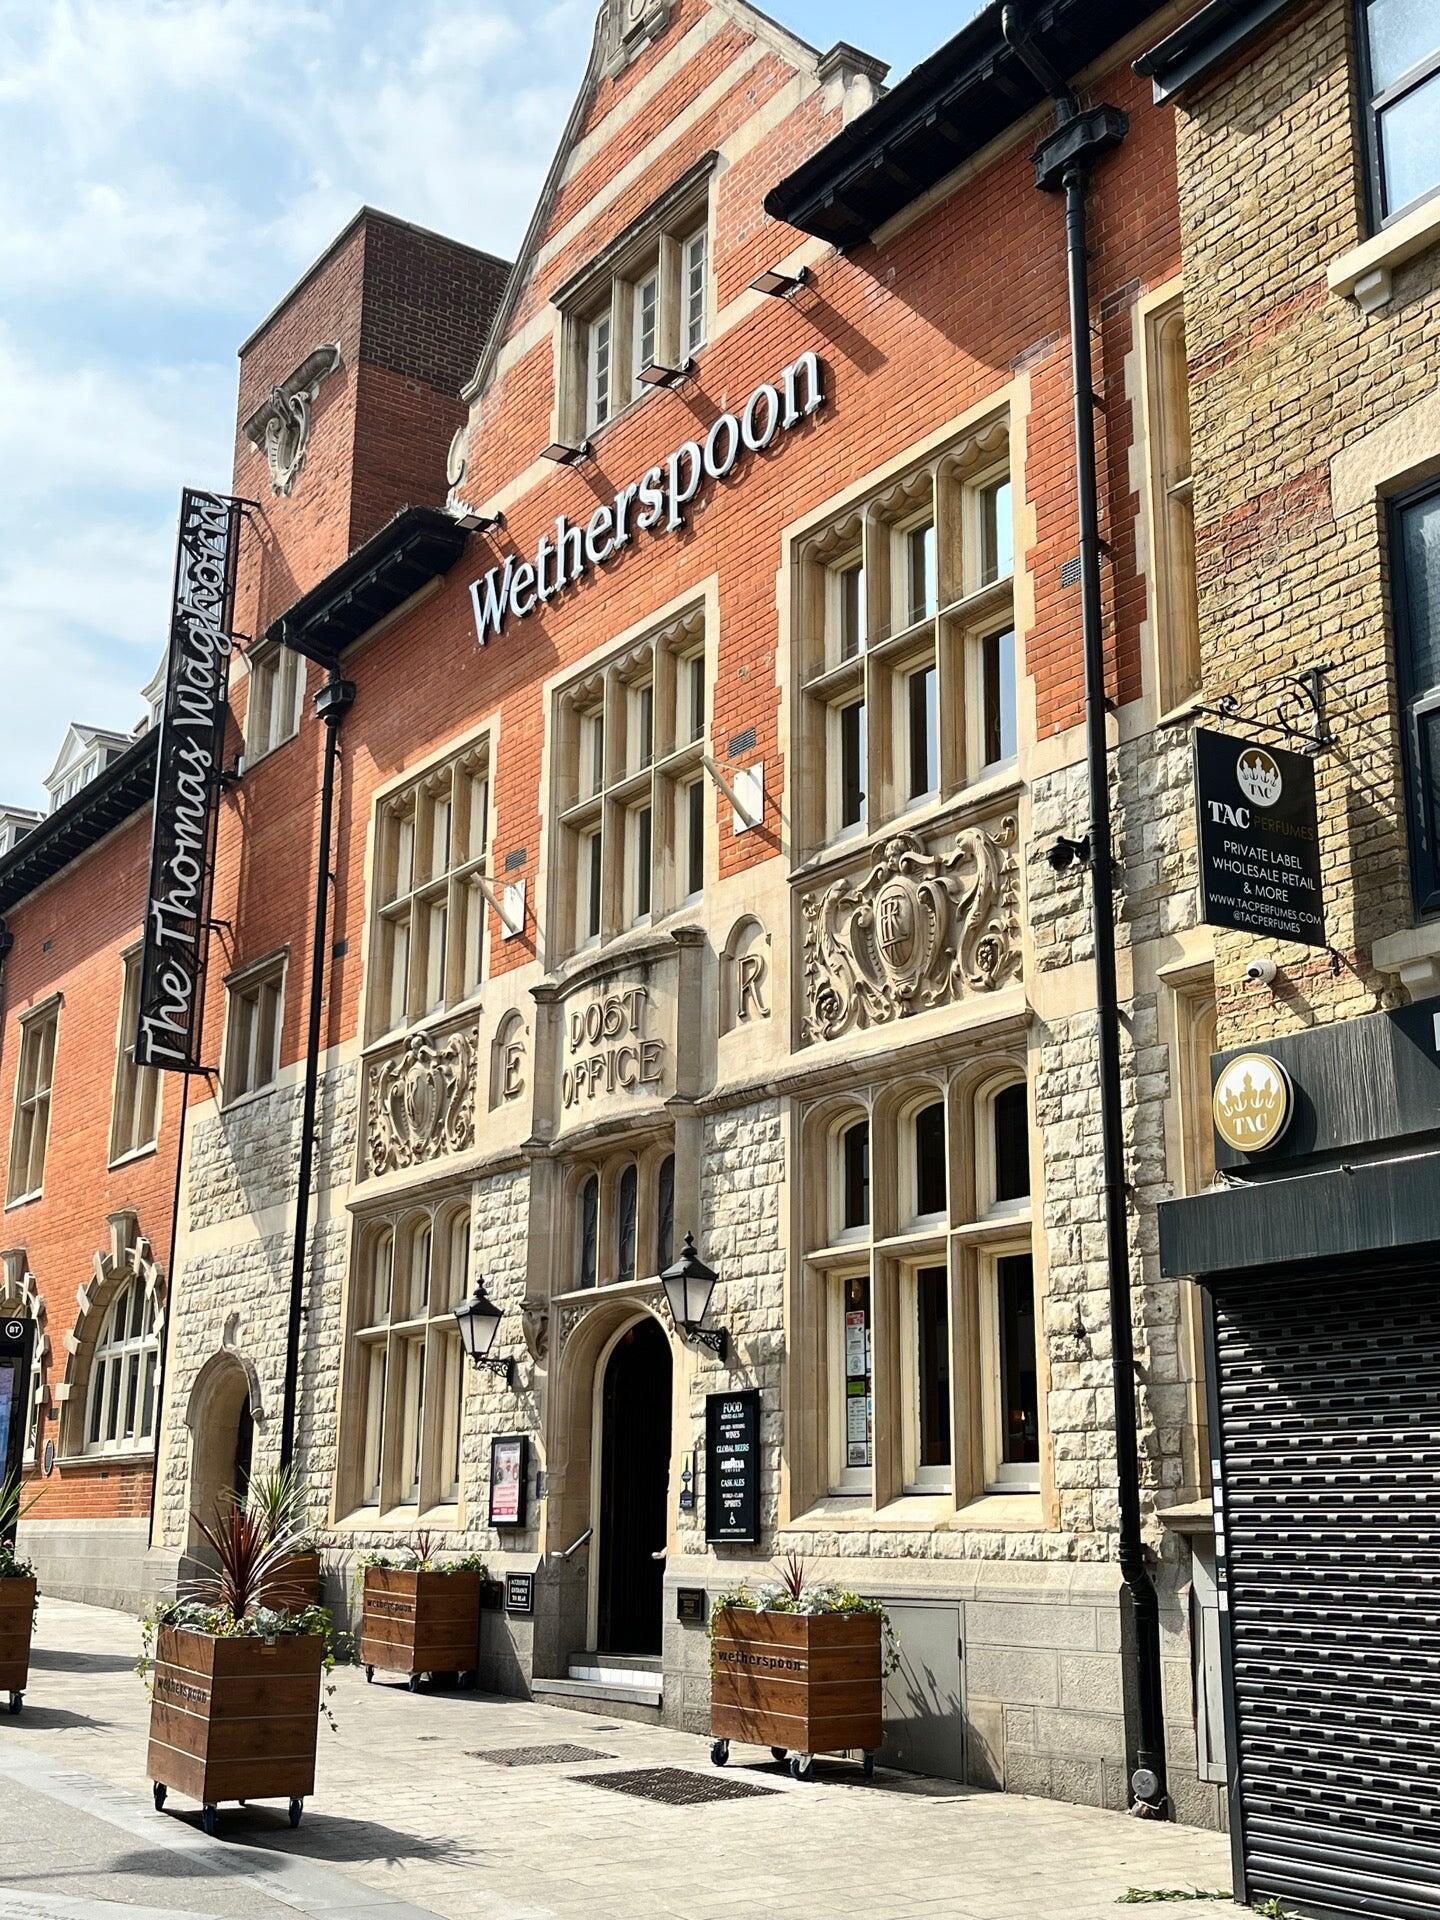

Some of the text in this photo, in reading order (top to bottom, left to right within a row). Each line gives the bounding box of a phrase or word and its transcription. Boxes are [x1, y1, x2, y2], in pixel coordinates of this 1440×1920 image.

[468, 350, 826, 646] Wetherspoon
[142, 490, 232, 1064] The Thomas Waghorn
[1249, 783, 1272, 799] TAC
[1207, 800, 1315, 841] TAC PERFUMES
[1223, 840, 1303, 870] PRIVATE LABEL
[1212, 856, 1316, 891] WHOLESALE RETAIL
[1243, 881, 1289, 903] & MORE
[1209, 892, 1322, 925] WWW.TACPERFUMES.COM
[1233, 910, 1300, 934] @TACPERFUMES
[737, 953, 771, 1018] R
[570, 986, 648, 1054] POST
[563, 1038, 665, 1109] OFFICE
[1232, 1112, 1268, 1136] TAC
[723, 1401, 743, 1413] FOOD
[716, 1444, 734, 1453] GLOBAL
[718, 1650, 801, 1672] wetherspoon
